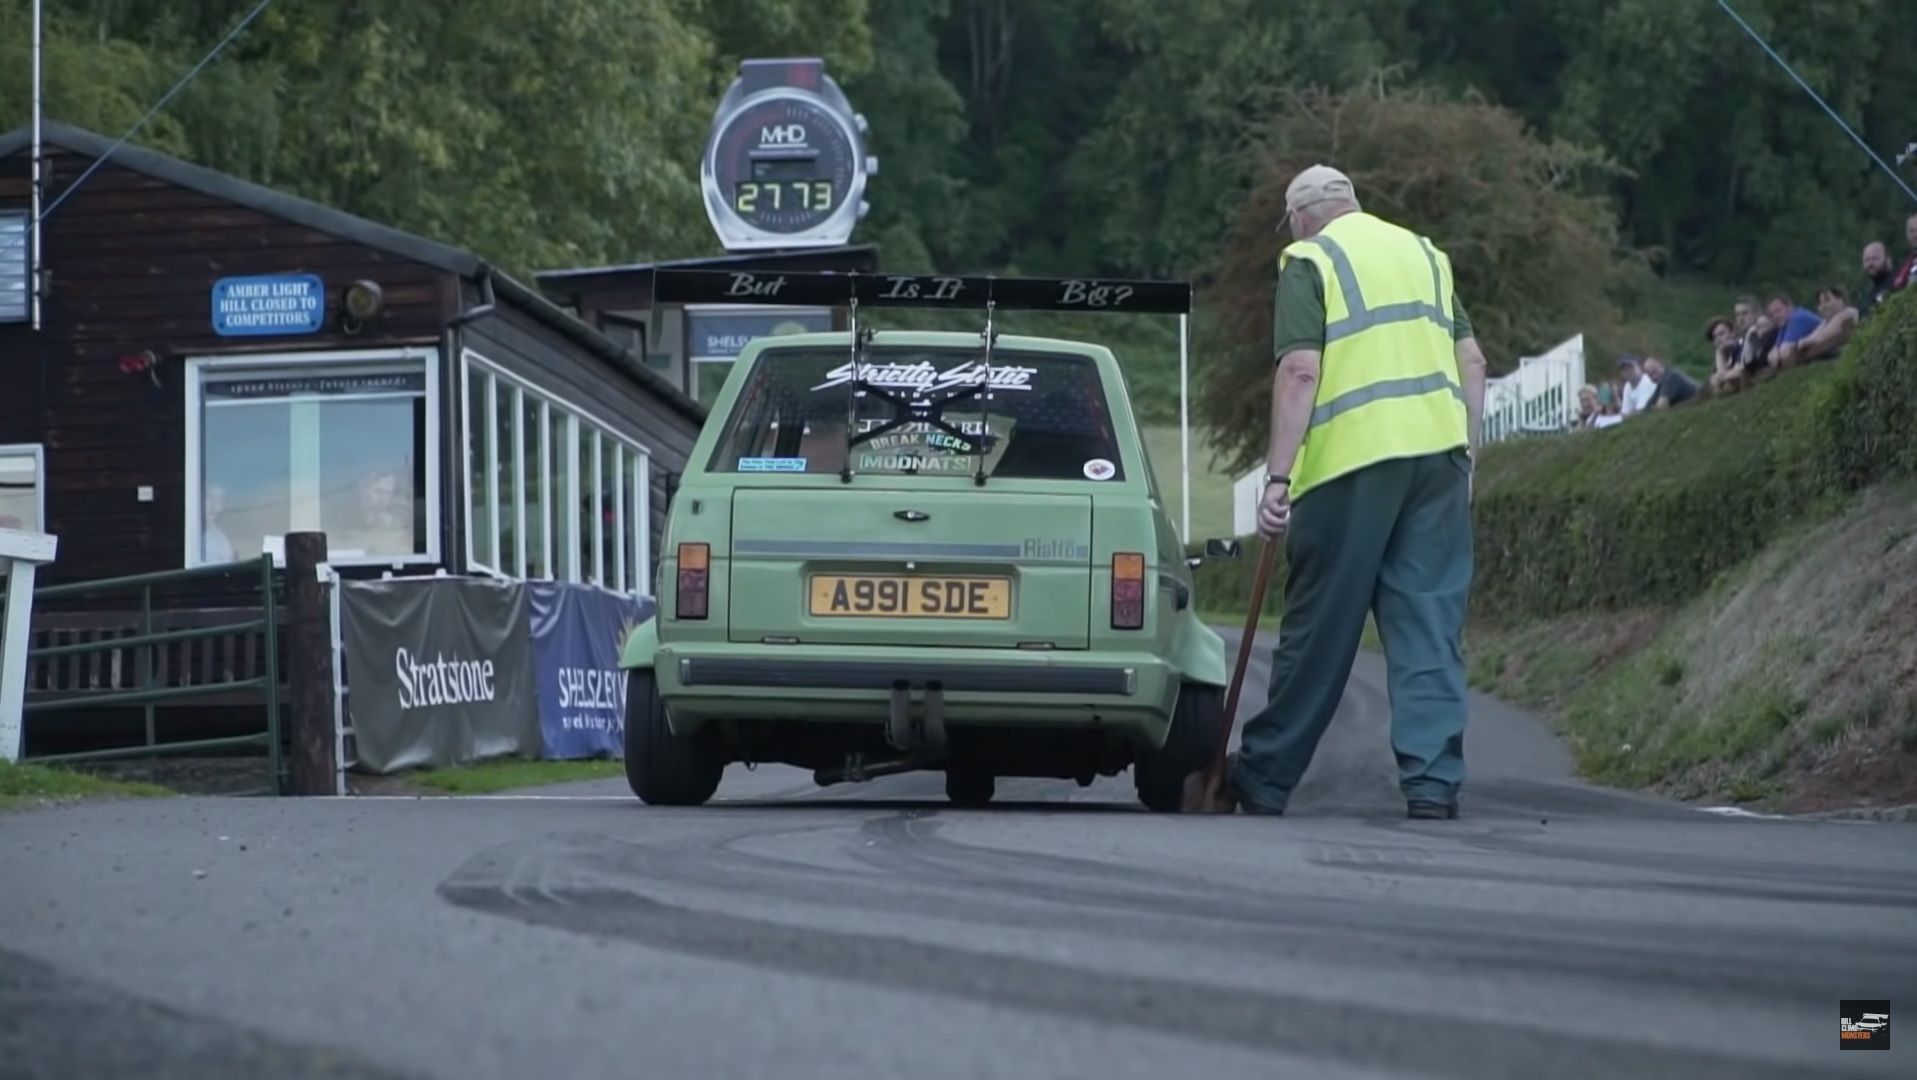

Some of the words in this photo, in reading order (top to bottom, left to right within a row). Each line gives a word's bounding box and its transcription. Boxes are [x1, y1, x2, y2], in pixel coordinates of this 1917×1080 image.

[227, 284, 269, 298] AMBER
[272, 282, 309, 296] LIGHT
[724, 272, 787, 296] But
[878, 276, 920, 298] Is
[922, 277, 966, 299] It
[1056, 279, 1134, 307] Big?
[220, 299, 248, 313] HILL
[250, 297, 297, 311] CLOSED
[300, 296, 316, 310] TO
[226, 311, 310, 327] COMPETITORS
[831, 580, 909, 612] A991
[921, 582, 990, 613] SDE
[396, 647, 494, 709] Stratstone
